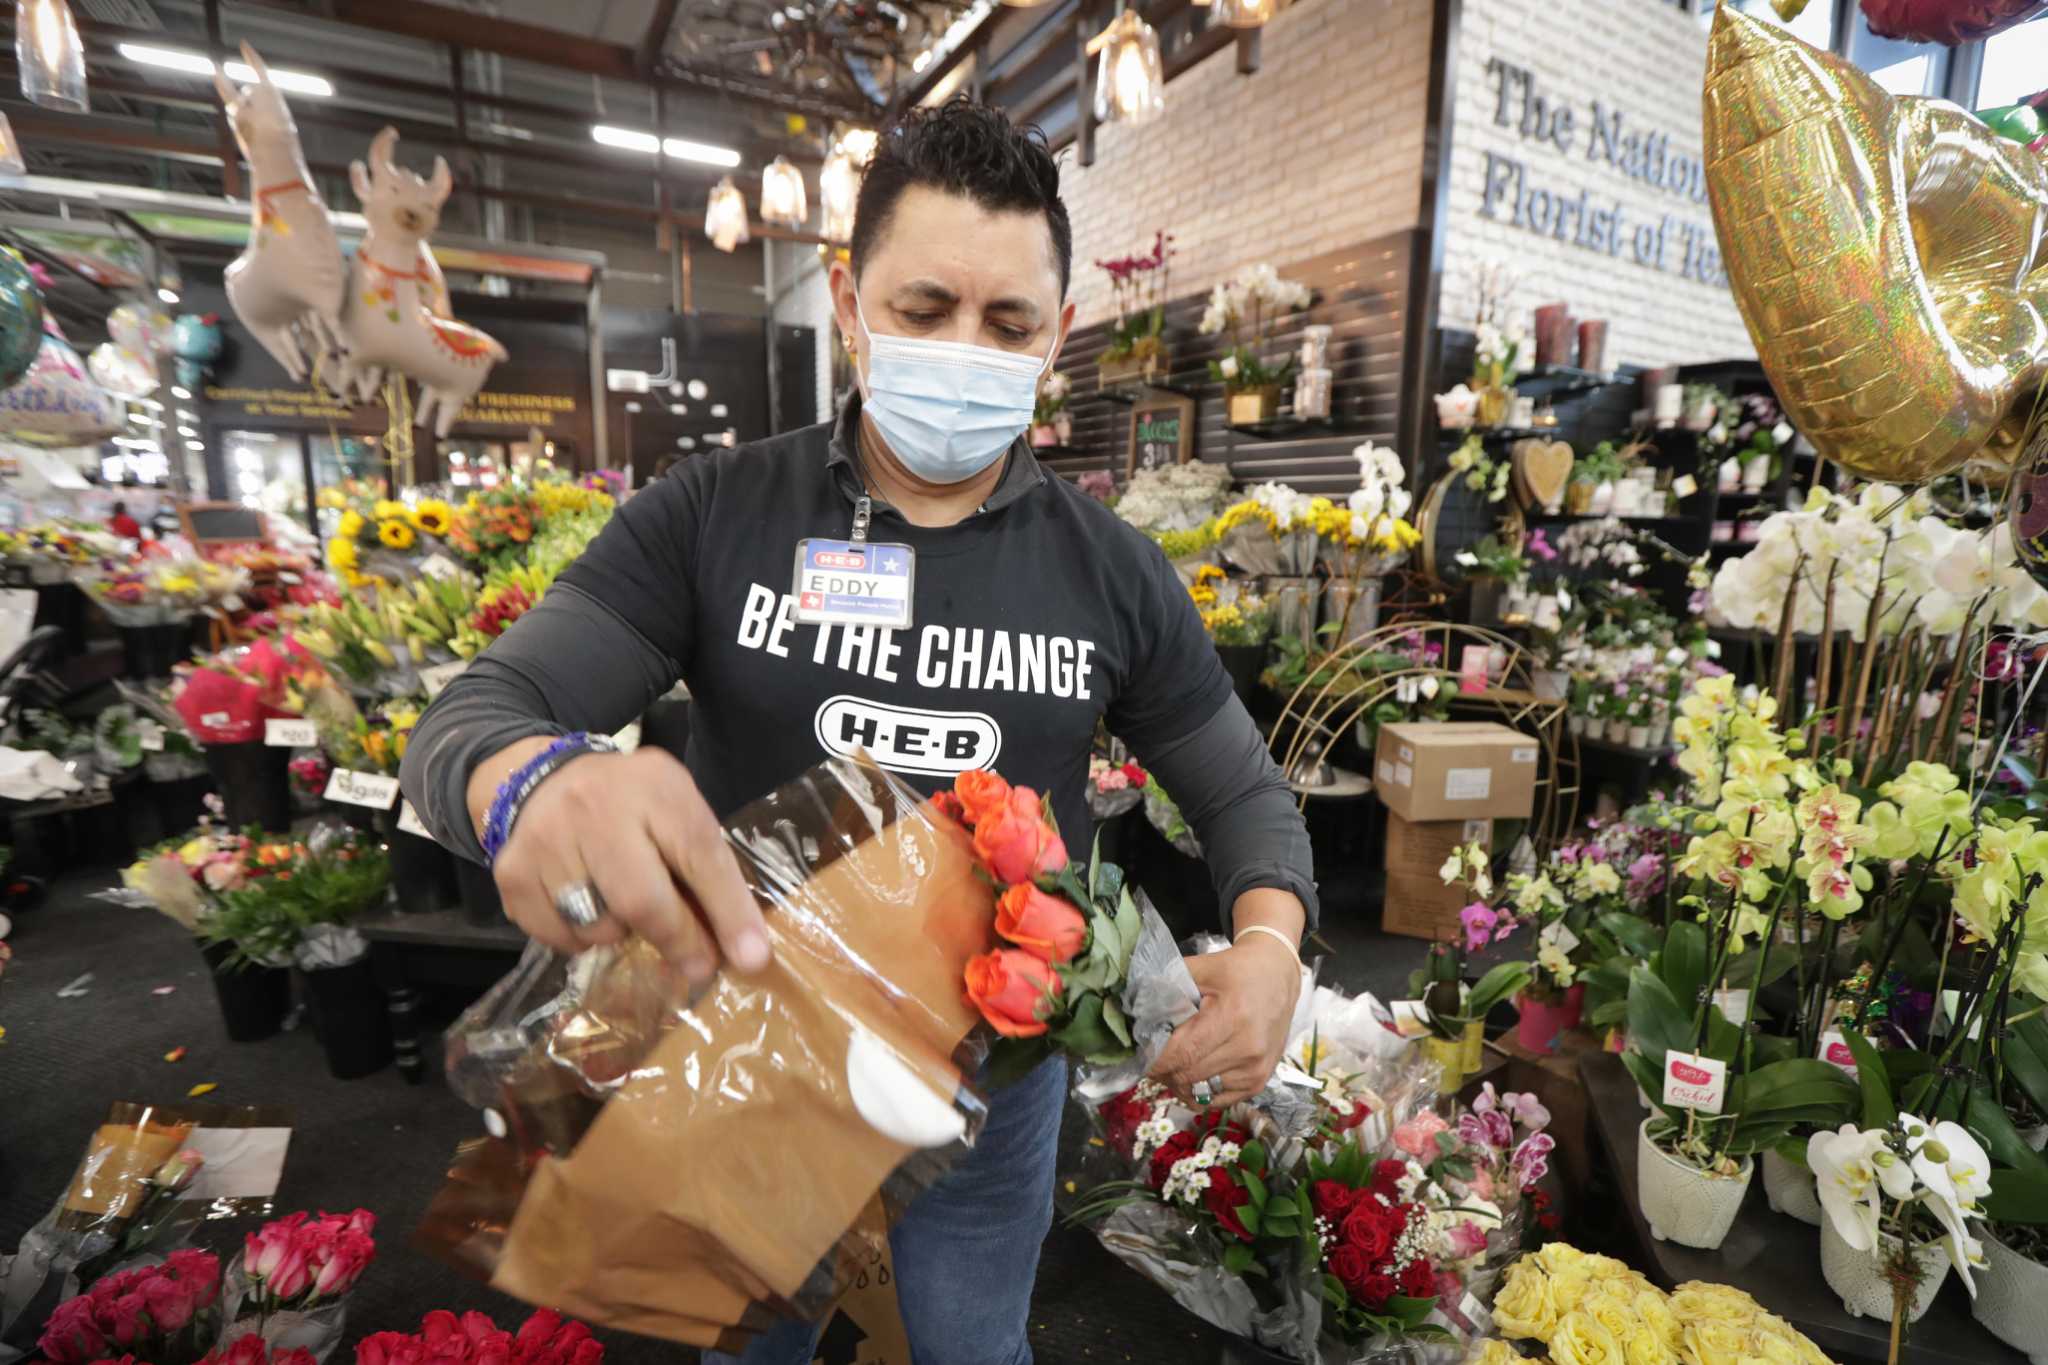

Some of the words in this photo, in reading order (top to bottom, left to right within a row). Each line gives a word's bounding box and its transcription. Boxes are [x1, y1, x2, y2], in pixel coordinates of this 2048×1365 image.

[1484, 56, 1576, 153] The
[1586, 99, 1709, 205] Nation
[1476, 150, 1624, 257] Florist
[1634, 213, 1680, 271] of
[1682, 221, 1729, 288] Te
[737, 582, 801, 658] BE
[916, 624, 1096, 700] CHANGE
[810, 575, 878, 596] EDDY
[840, 712, 981, 760] H-E-B
